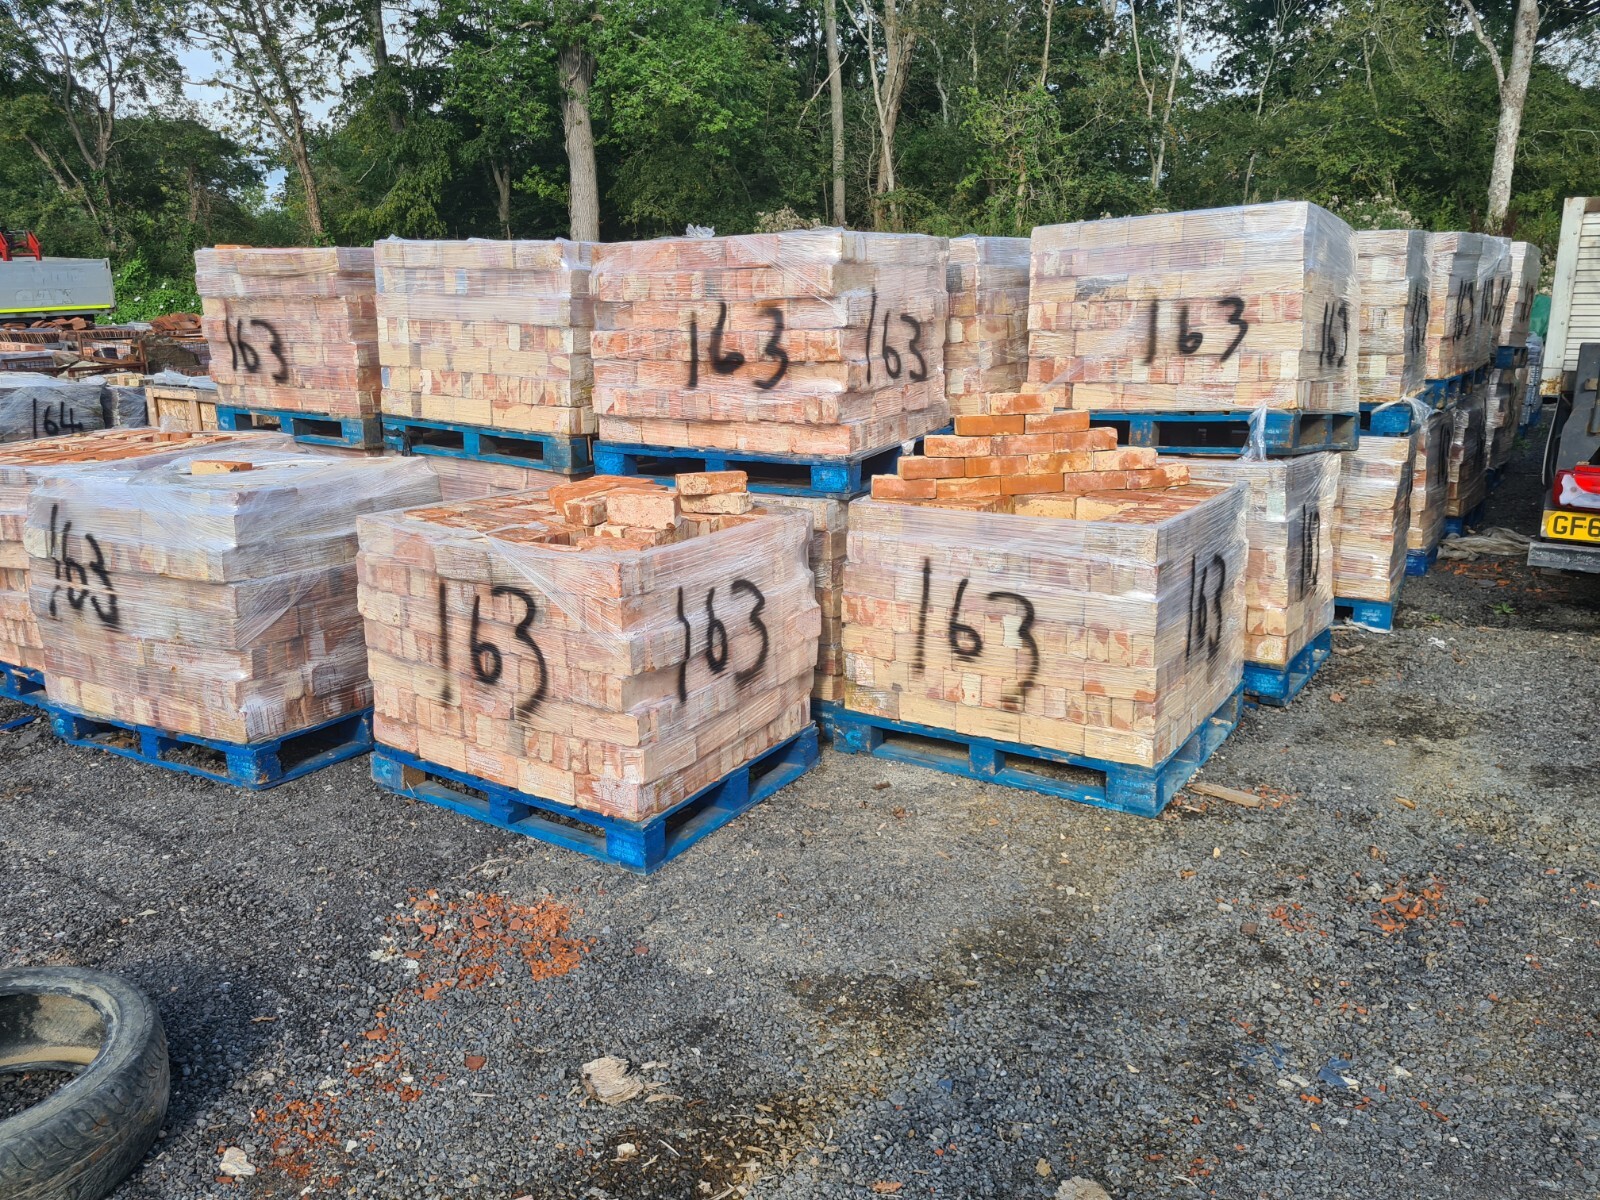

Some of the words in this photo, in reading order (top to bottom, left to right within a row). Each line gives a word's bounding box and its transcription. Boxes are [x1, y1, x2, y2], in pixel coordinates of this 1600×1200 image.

[225, 306, 289, 383] 163
[688, 302, 788, 390] 163
[866, 287, 928, 384] 163
[1144, 296, 1248, 364] 163
[1319, 300, 1348, 369] 163
[32, 398, 83, 439] 164
[49, 504, 121, 632] 163
[1184, 554, 1226, 672] 163
[439, 583, 548, 720] 163
[678, 579, 769, 704] 163
[912, 557, 1039, 708] 163
